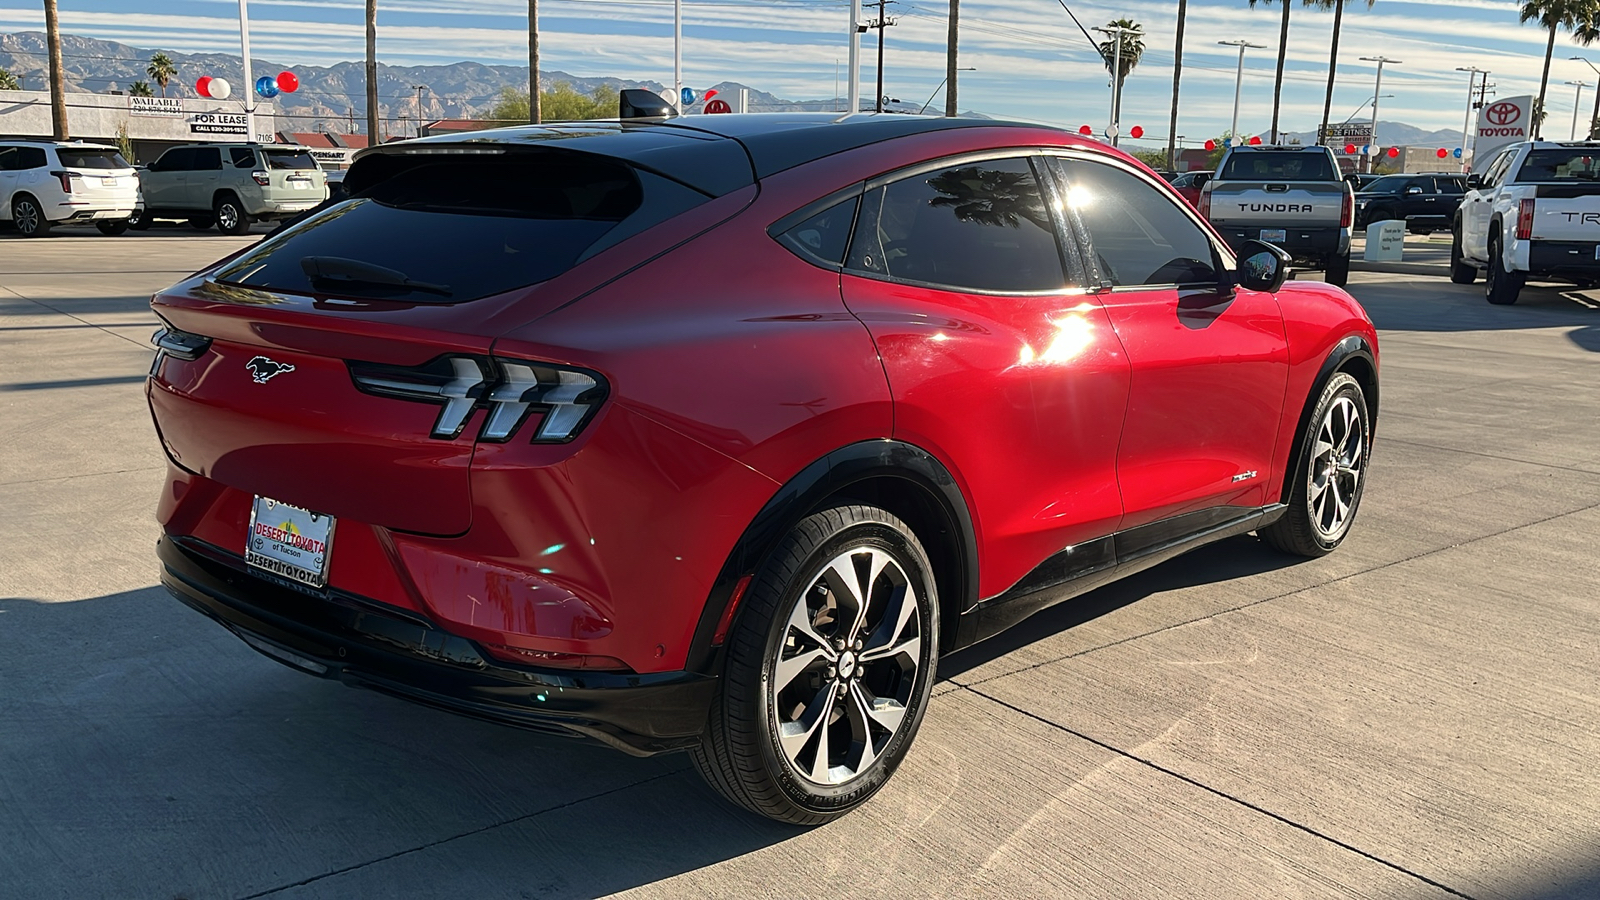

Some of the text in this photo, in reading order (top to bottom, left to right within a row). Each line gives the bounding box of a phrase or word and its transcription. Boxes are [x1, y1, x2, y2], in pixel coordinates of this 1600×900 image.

[131, 98, 182, 107] AVAILABLE
[195, 114, 247, 124] FOR LEASE
[1343, 128, 1372, 136] FITNESS
[1478, 127, 1524, 137] TOYOTA
[258, 133, 273, 142] 7105
[311, 151, 346, 159] PENSARY
[1237, 203, 1313, 213] TUNDRA
[255, 522, 326, 554] DESERT TOYOTA
[272, 544, 301, 558] of Tucson
[248, 552, 318, 585] DESERT TOYOTA
